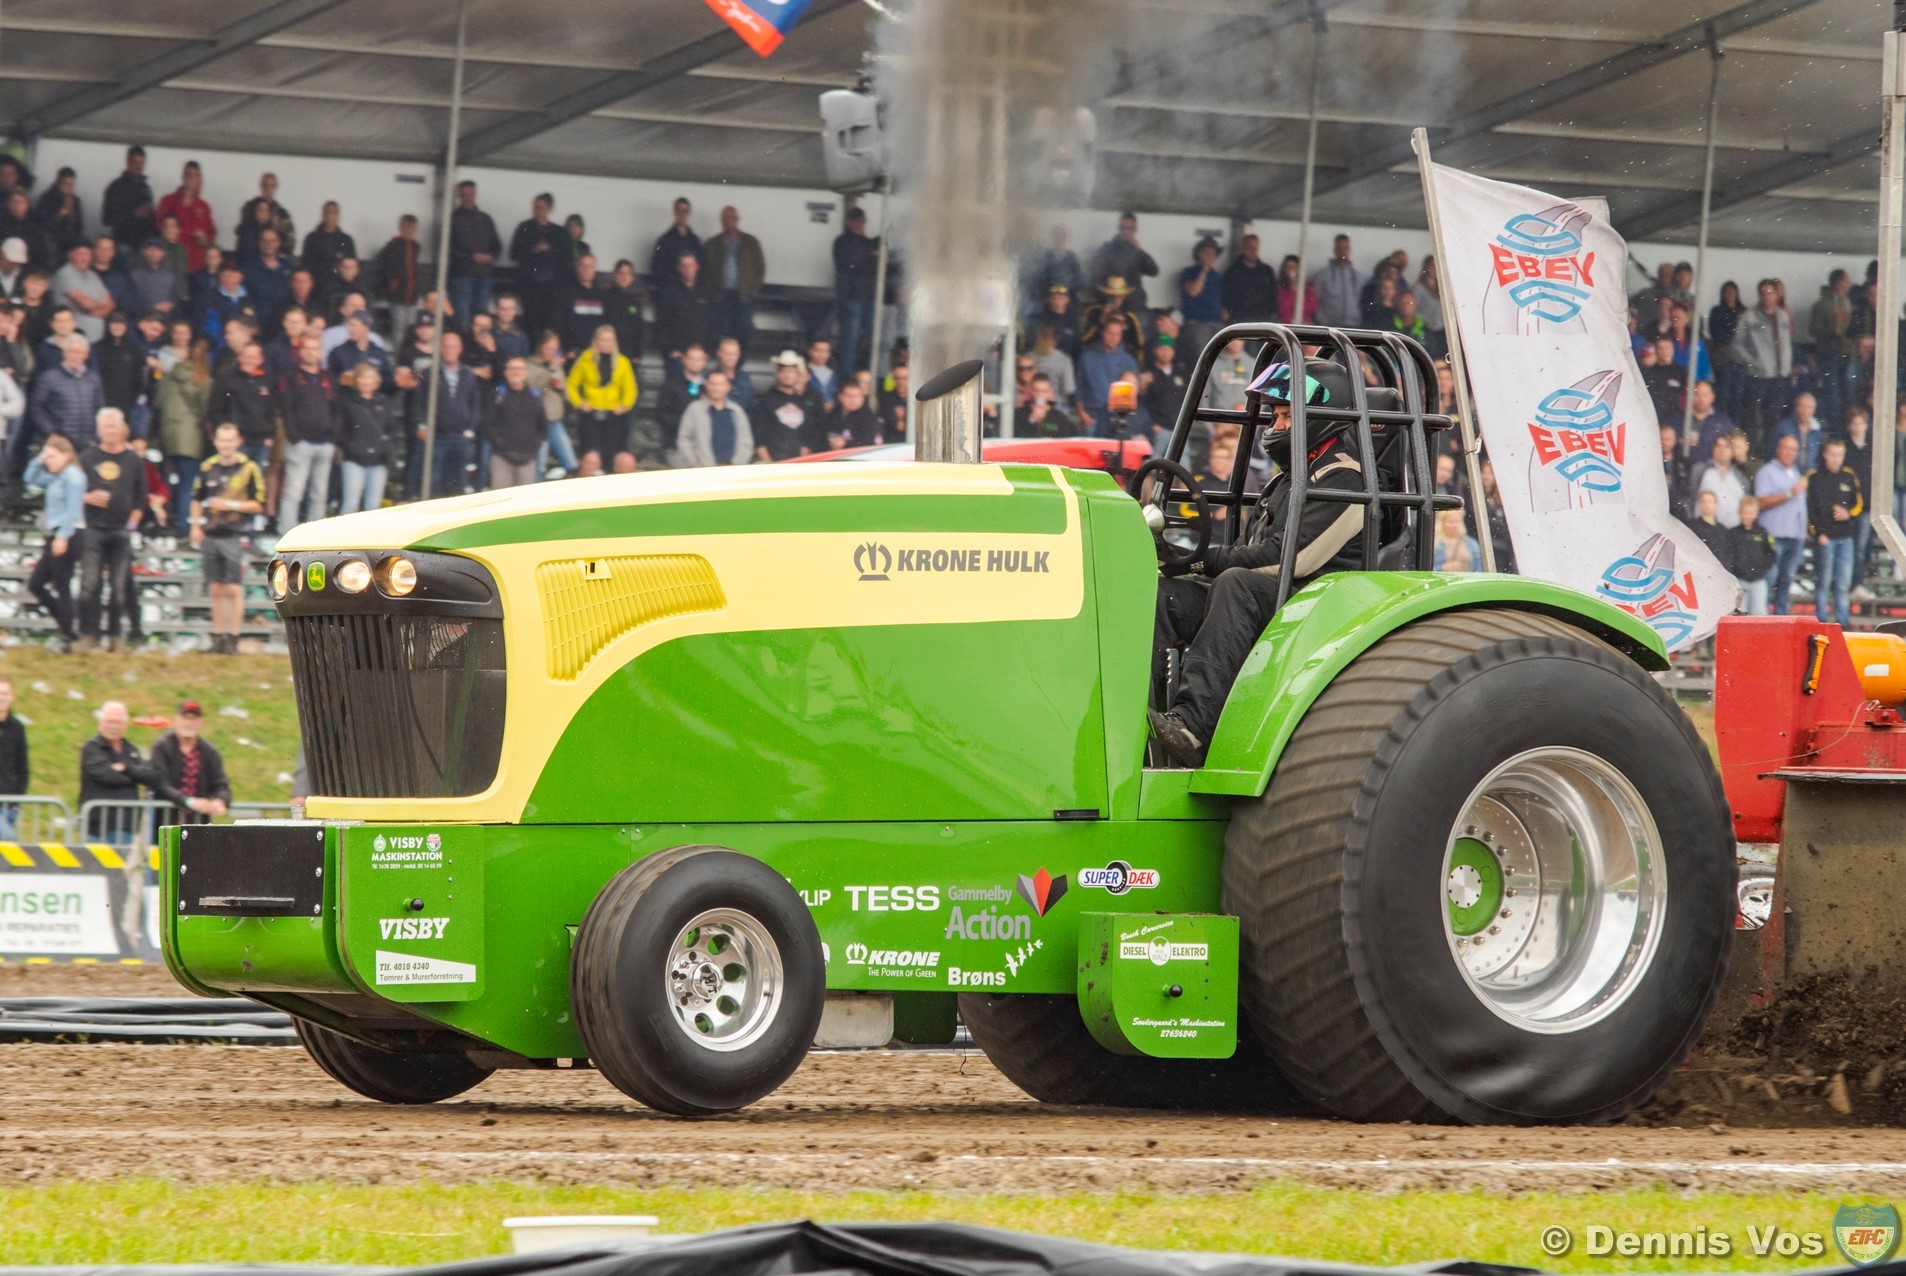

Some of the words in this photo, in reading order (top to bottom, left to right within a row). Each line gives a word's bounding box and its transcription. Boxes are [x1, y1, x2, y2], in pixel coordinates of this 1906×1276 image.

[1488, 243, 1596, 288] EBEV
[1527, 422, 1626, 466] EBEV
[897, 549, 982, 572] KRONE
[986, 550, 1050, 573] HULK
[389, 837, 424, 849] VISBY
[371, 852, 443, 861] MASKINSTATION
[1084, 871, 1119, 884] SUPER
[1128, 872, 1155, 885] DÆK
[844, 886, 939, 911] TESS
[948, 885, 1012, 905] Gammelby
[379, 918, 449, 940] VISBY
[945, 905, 1031, 940] Action
[868, 950, 941, 966] KRONE
[1123, 947, 1146, 956] DIESEL
[1172, 947, 1206, 957] ELEKTRO
[393, 962, 410, 970] 4018
[413, 962, 429, 970] 4340
[411, 973, 463, 982] Murerforretning
[947, 967, 1006, 986] Brøns
[1180, 1018, 1225, 1027] Maskinstation
[1160, 1029, 1197, 1038] 27636240
